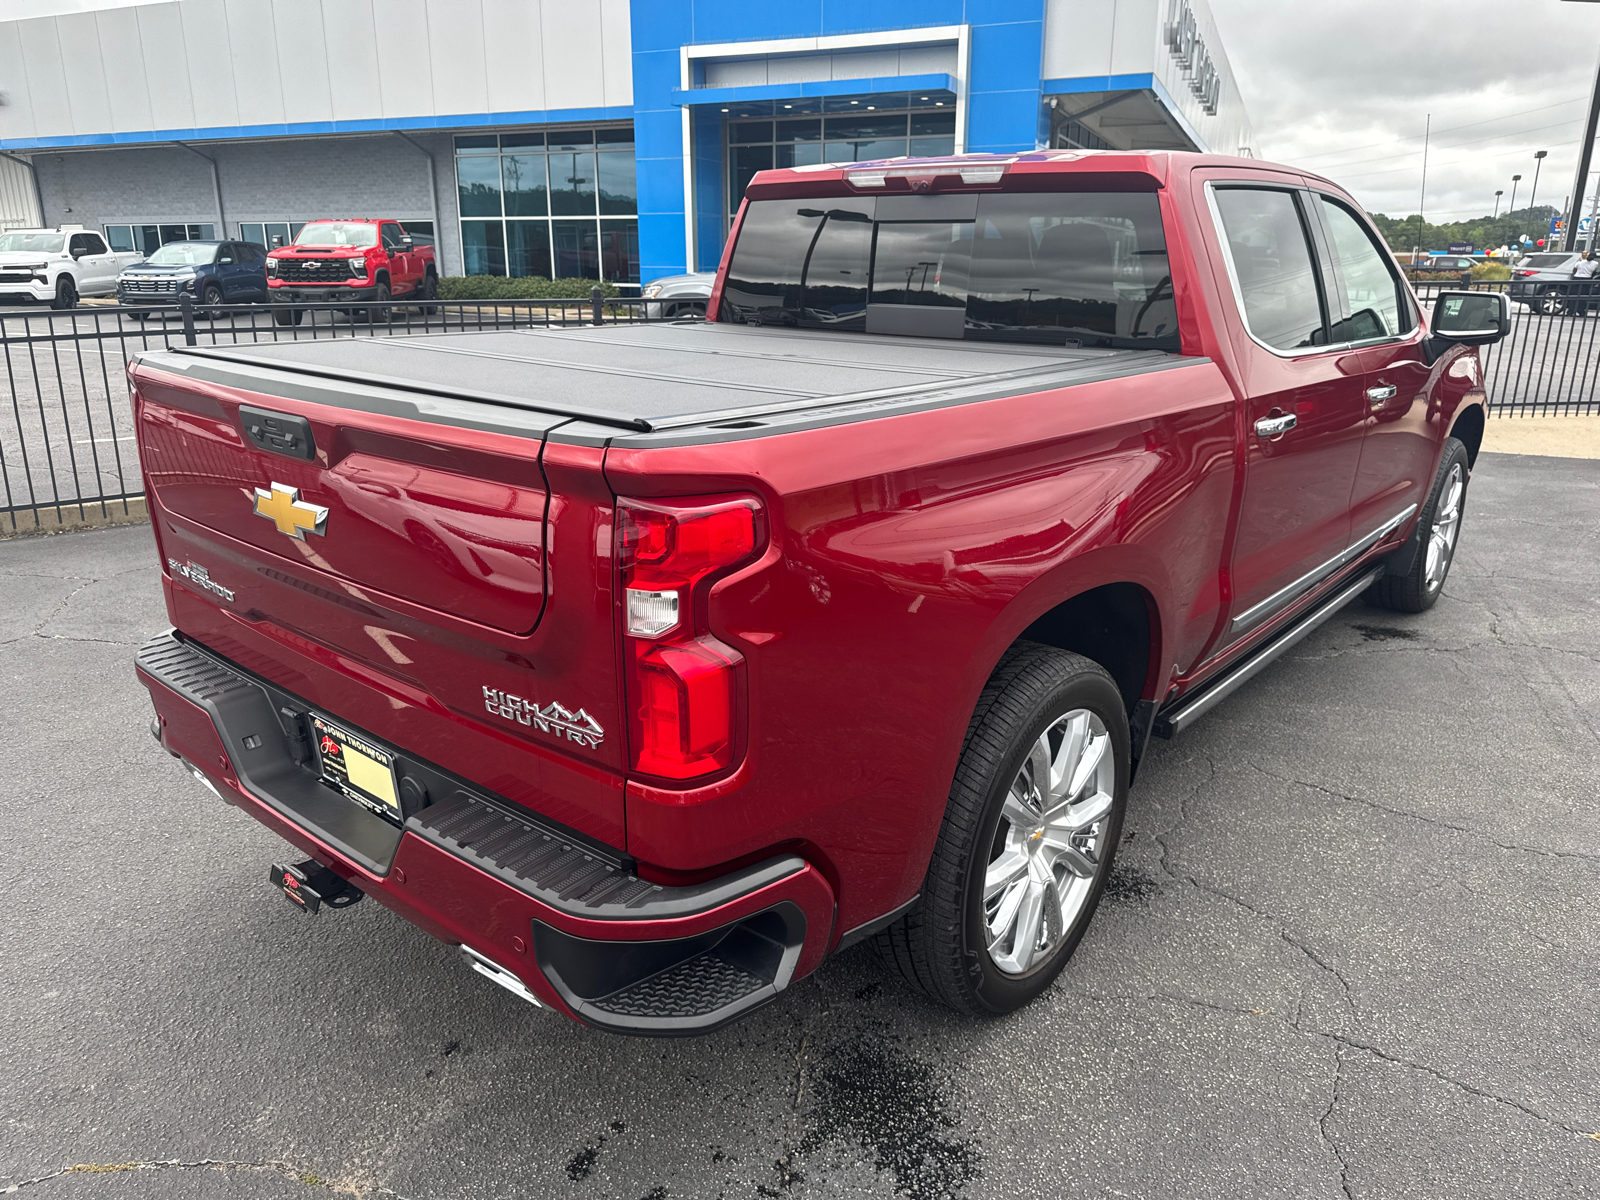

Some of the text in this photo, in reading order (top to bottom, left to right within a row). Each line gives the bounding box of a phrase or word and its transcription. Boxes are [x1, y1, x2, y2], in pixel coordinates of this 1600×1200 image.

[168, 558, 235, 602] SILVERADO
[482, 685, 541, 716] HIGH
[327, 725, 346, 742] JOHN
[347, 735, 388, 765] THORNTON
[485, 700, 604, 749] COUNTRY
